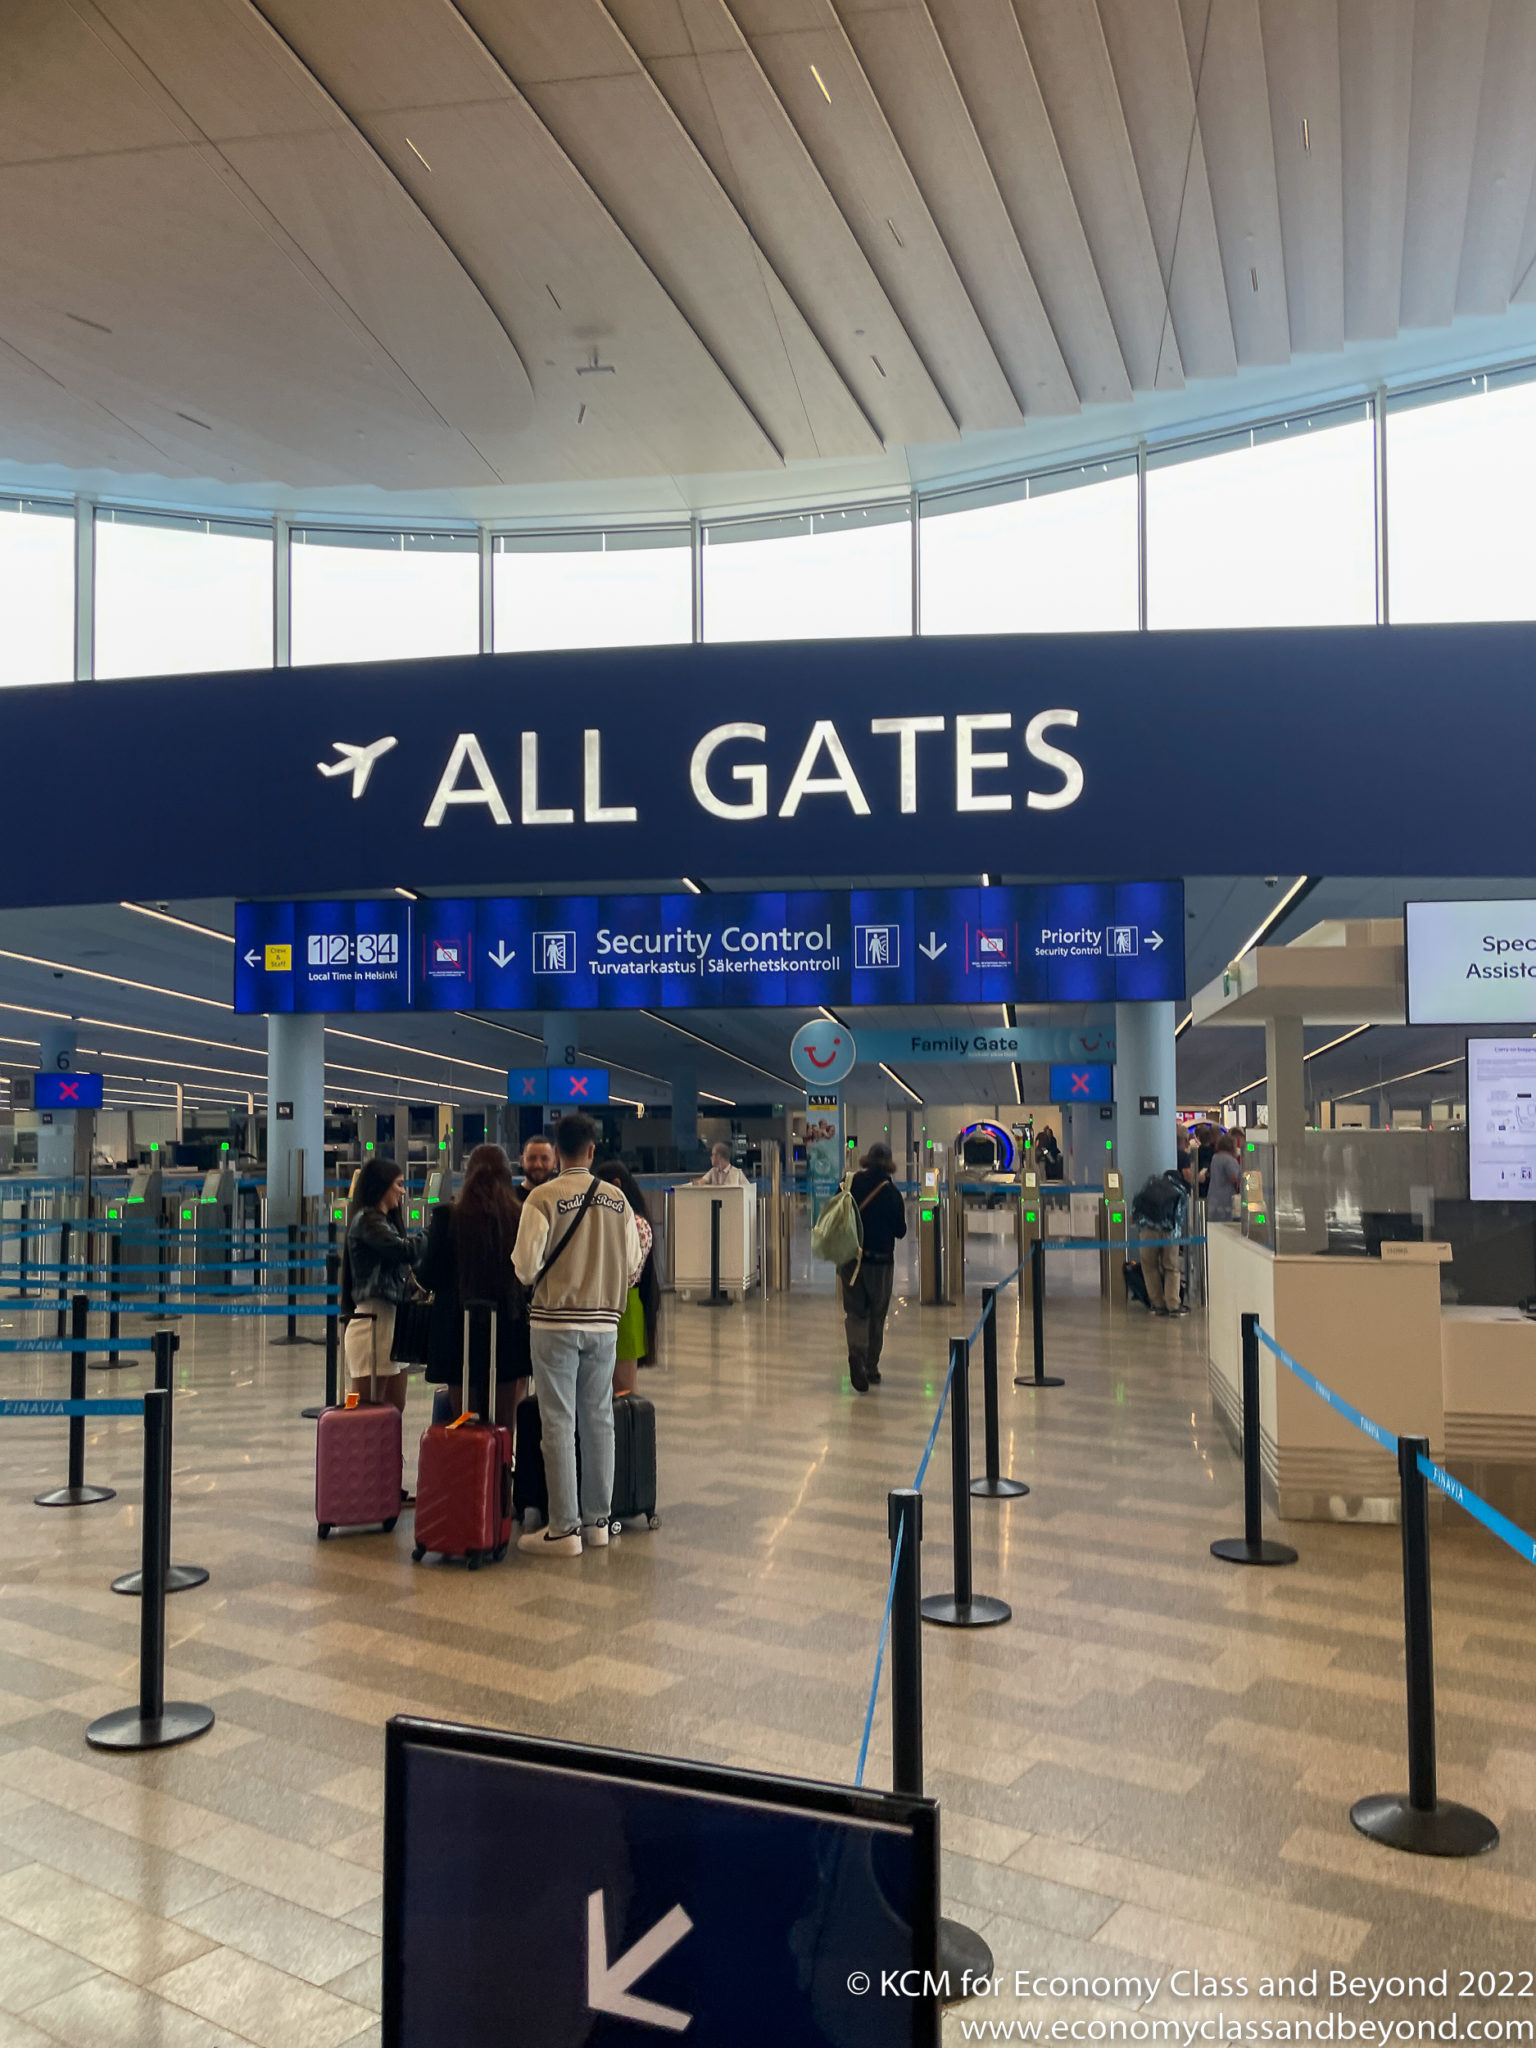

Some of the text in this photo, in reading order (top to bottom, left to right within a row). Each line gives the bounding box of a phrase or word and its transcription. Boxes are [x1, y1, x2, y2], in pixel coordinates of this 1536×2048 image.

[423, 709, 1085, 828] ALL GATES
[596, 923, 832, 959] Security Control
[1041, 928, 1102, 946] Priority
[1482, 935, 1536, 955] Spec
[308, 934, 398, 964] 12:34
[1034, 946, 1102, 957] Security Control
[589, 956, 840, 975] Turvatarkastus Säkerhetskontroll
[308, 970, 398, 981] Local Time in Helsinki
[911, 1036, 1018, 1054] Family Gate
[56, 1050, 70, 1070] 6
[564, 1045, 576, 1065] 8
[558, 1194, 595, 1213] Sadd
[220, 1306, 264, 1314] FINAVIA
[15, 1341, 63, 1351] FINAVIA
[3, 1402, 65, 1414] FINAVIA
[1433, 1466, 1464, 1503] FINAVIA
